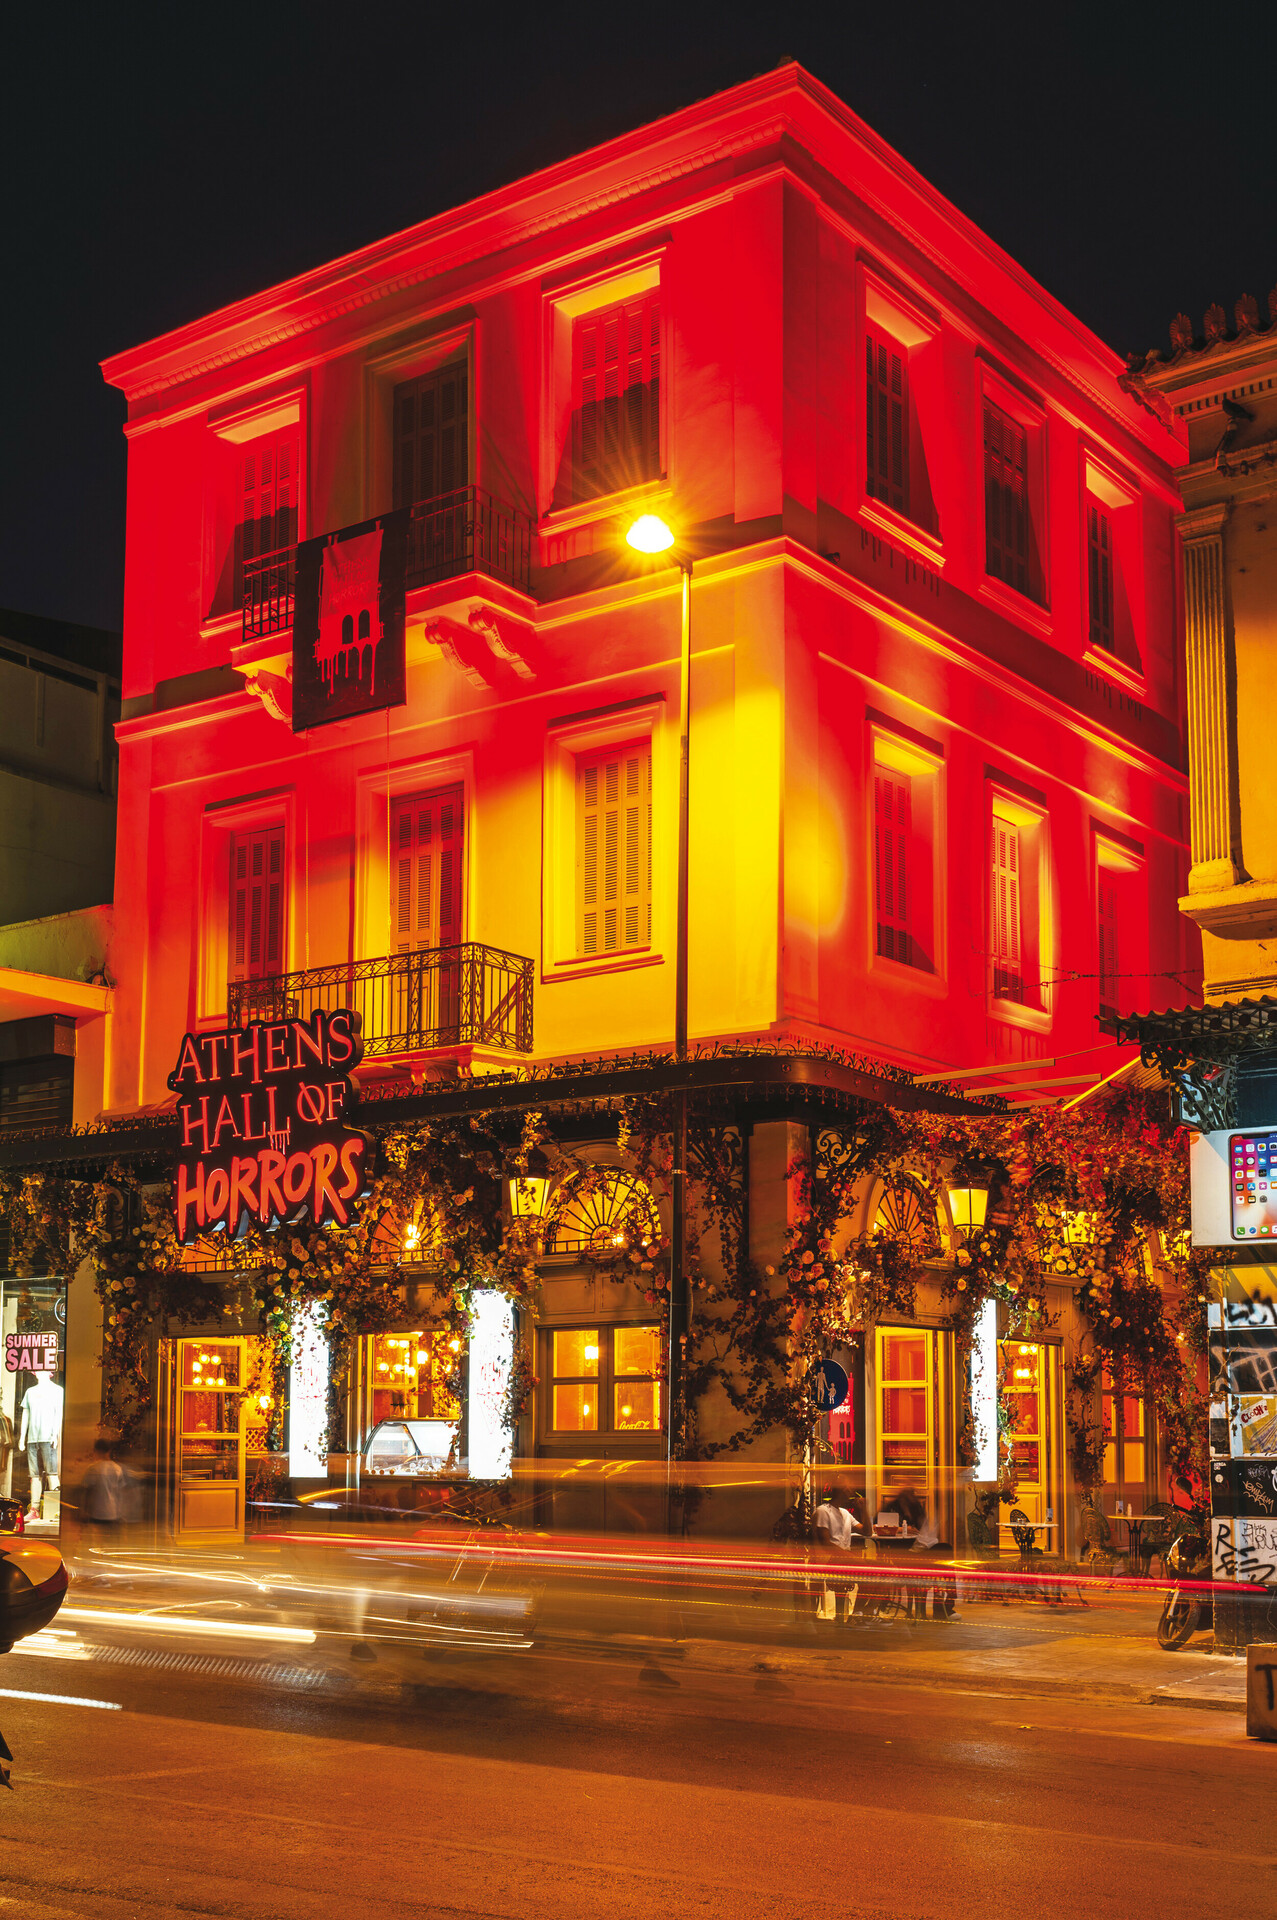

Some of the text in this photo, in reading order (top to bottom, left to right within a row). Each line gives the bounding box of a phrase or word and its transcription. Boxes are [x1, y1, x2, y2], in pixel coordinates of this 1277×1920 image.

[175, 1013, 353, 1084] ATHENS
[180, 1081, 347, 1154] HALL OF
[176, 1137, 364, 1242] HORRORS
[6, 1334, 57, 1348] SUMMER
[6, 1348, 57, 1371] SALE
